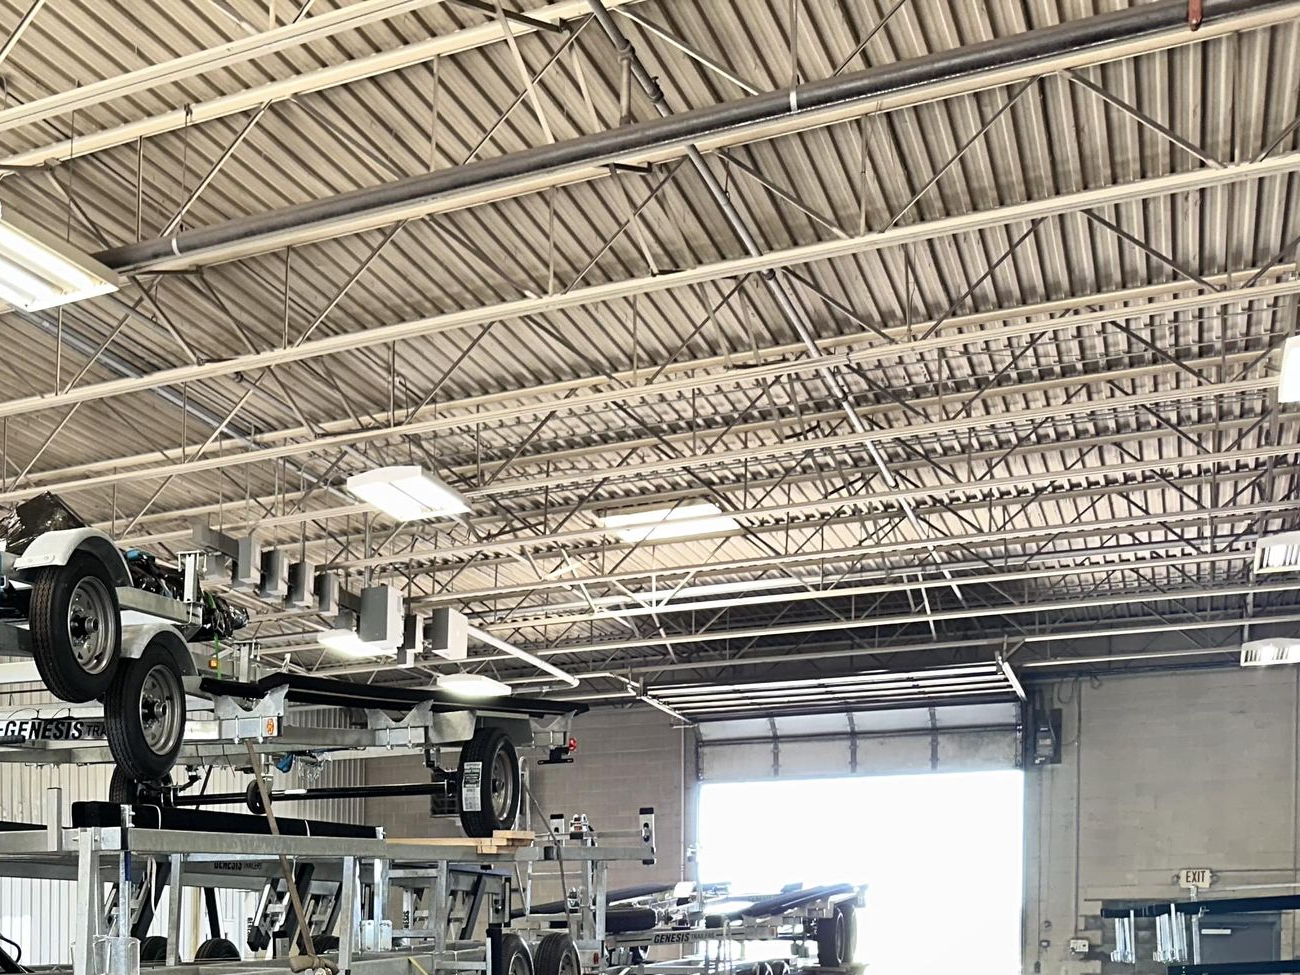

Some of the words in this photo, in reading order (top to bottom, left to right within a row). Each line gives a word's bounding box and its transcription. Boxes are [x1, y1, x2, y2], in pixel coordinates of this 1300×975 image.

[4, 720, 84, 740] GENESIS
[1186, 870, 1206, 883] EXIT
[654, 933, 690, 943] GENESIS
